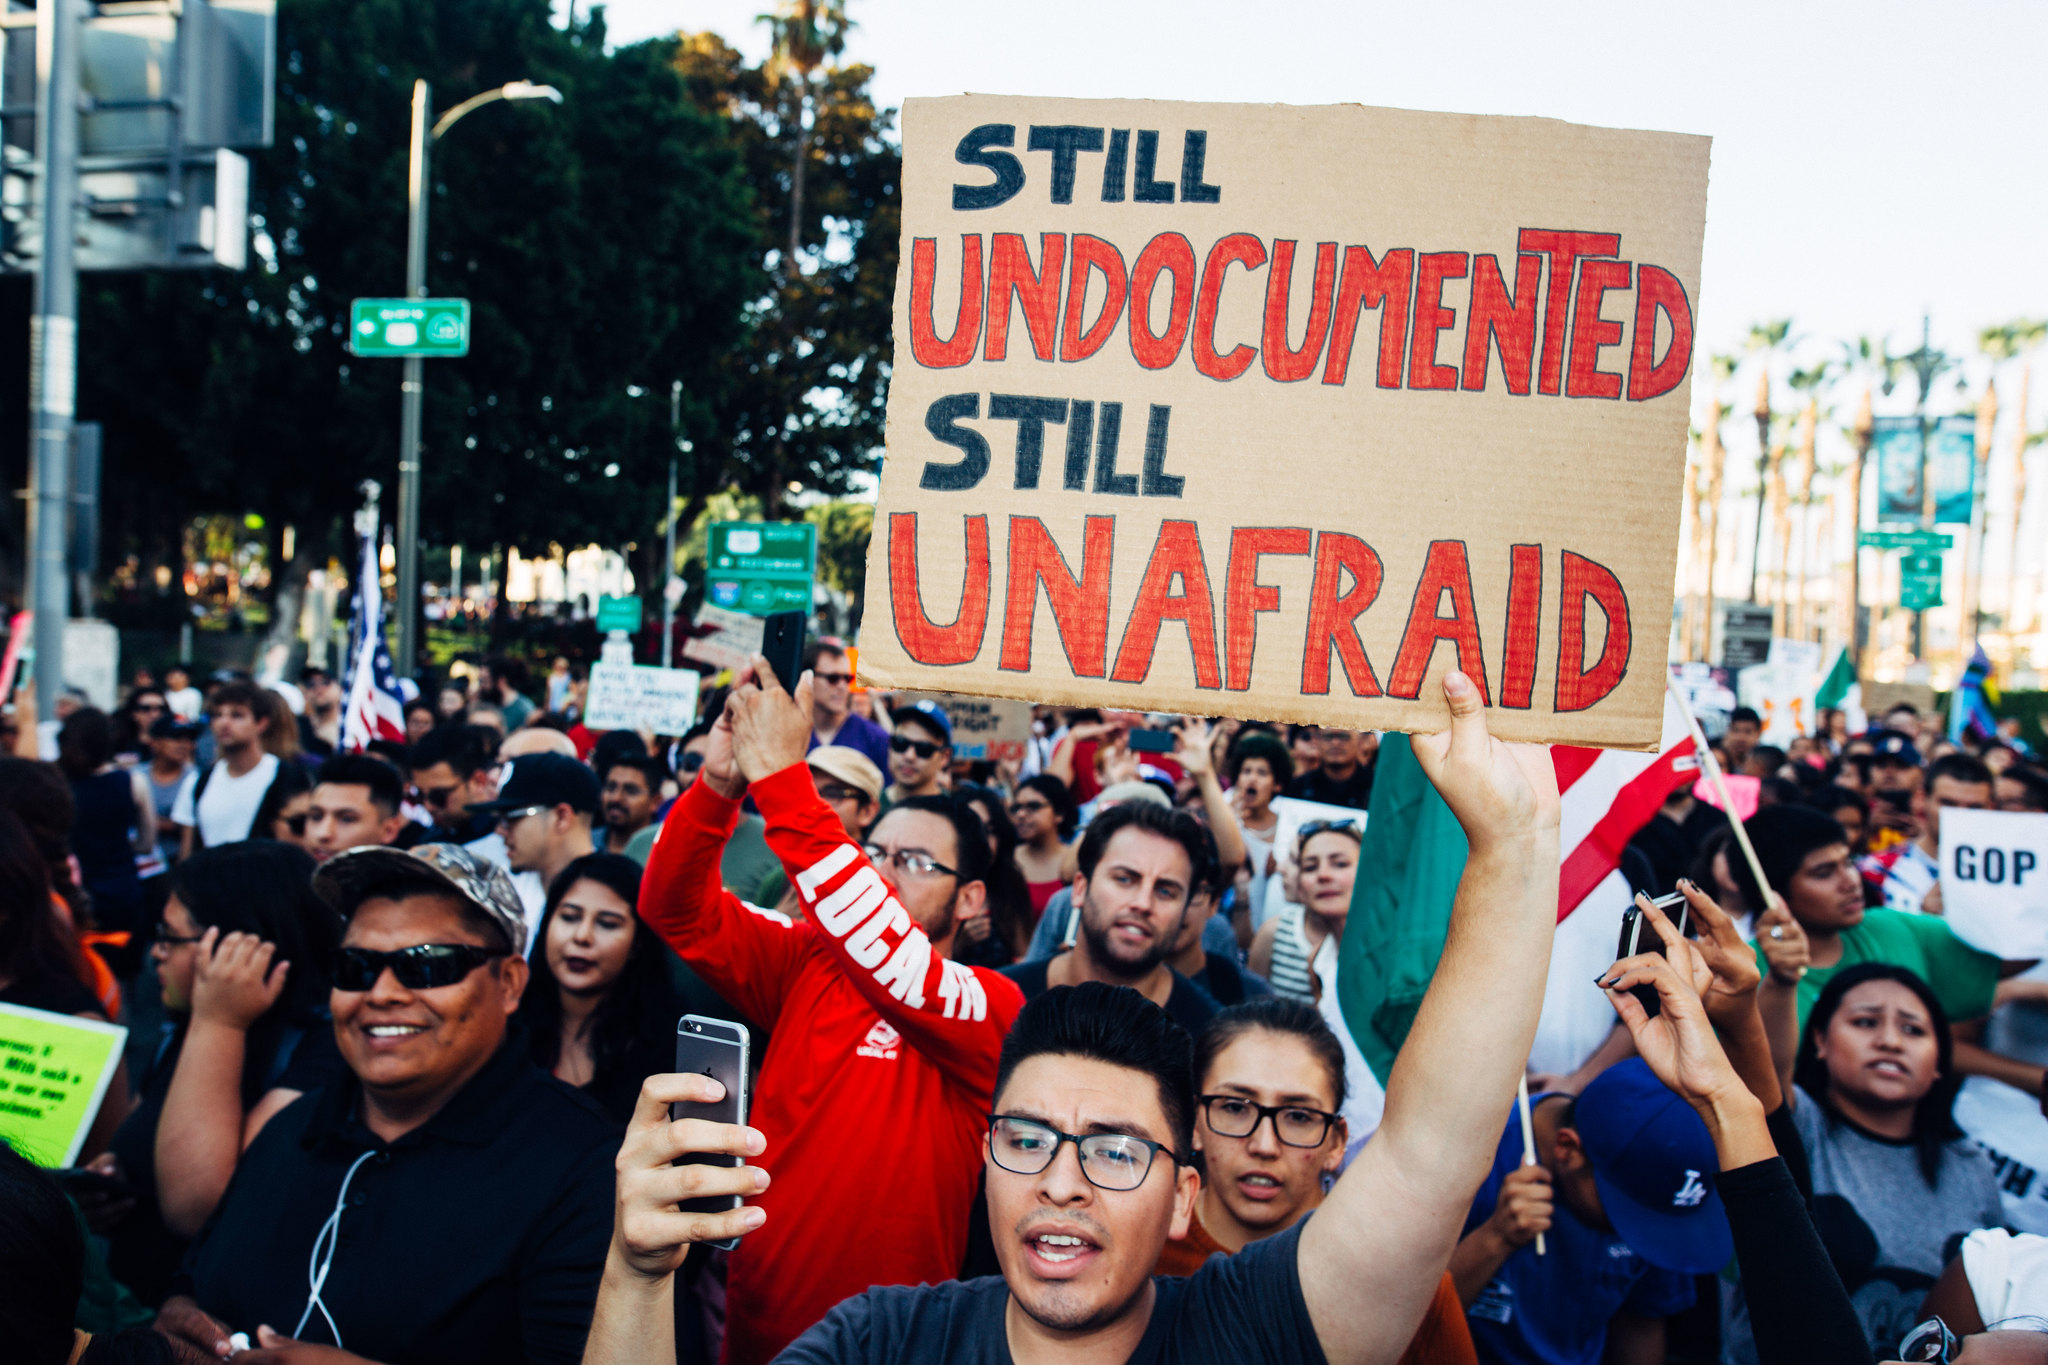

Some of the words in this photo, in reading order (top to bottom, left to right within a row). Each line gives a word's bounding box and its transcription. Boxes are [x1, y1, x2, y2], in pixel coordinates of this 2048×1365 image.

[952, 123, 1221, 210] STILL
[909, 227, 1694, 401] UNDOCUMENTED
[919, 393, 1186, 498] STILL
[888, 511, 1632, 712] UNAFRAID
[1955, 844, 2036, 886] GOP
[796, 843, 932, 1010] LOCAL
[1673, 1169, 1707, 1206] LA
